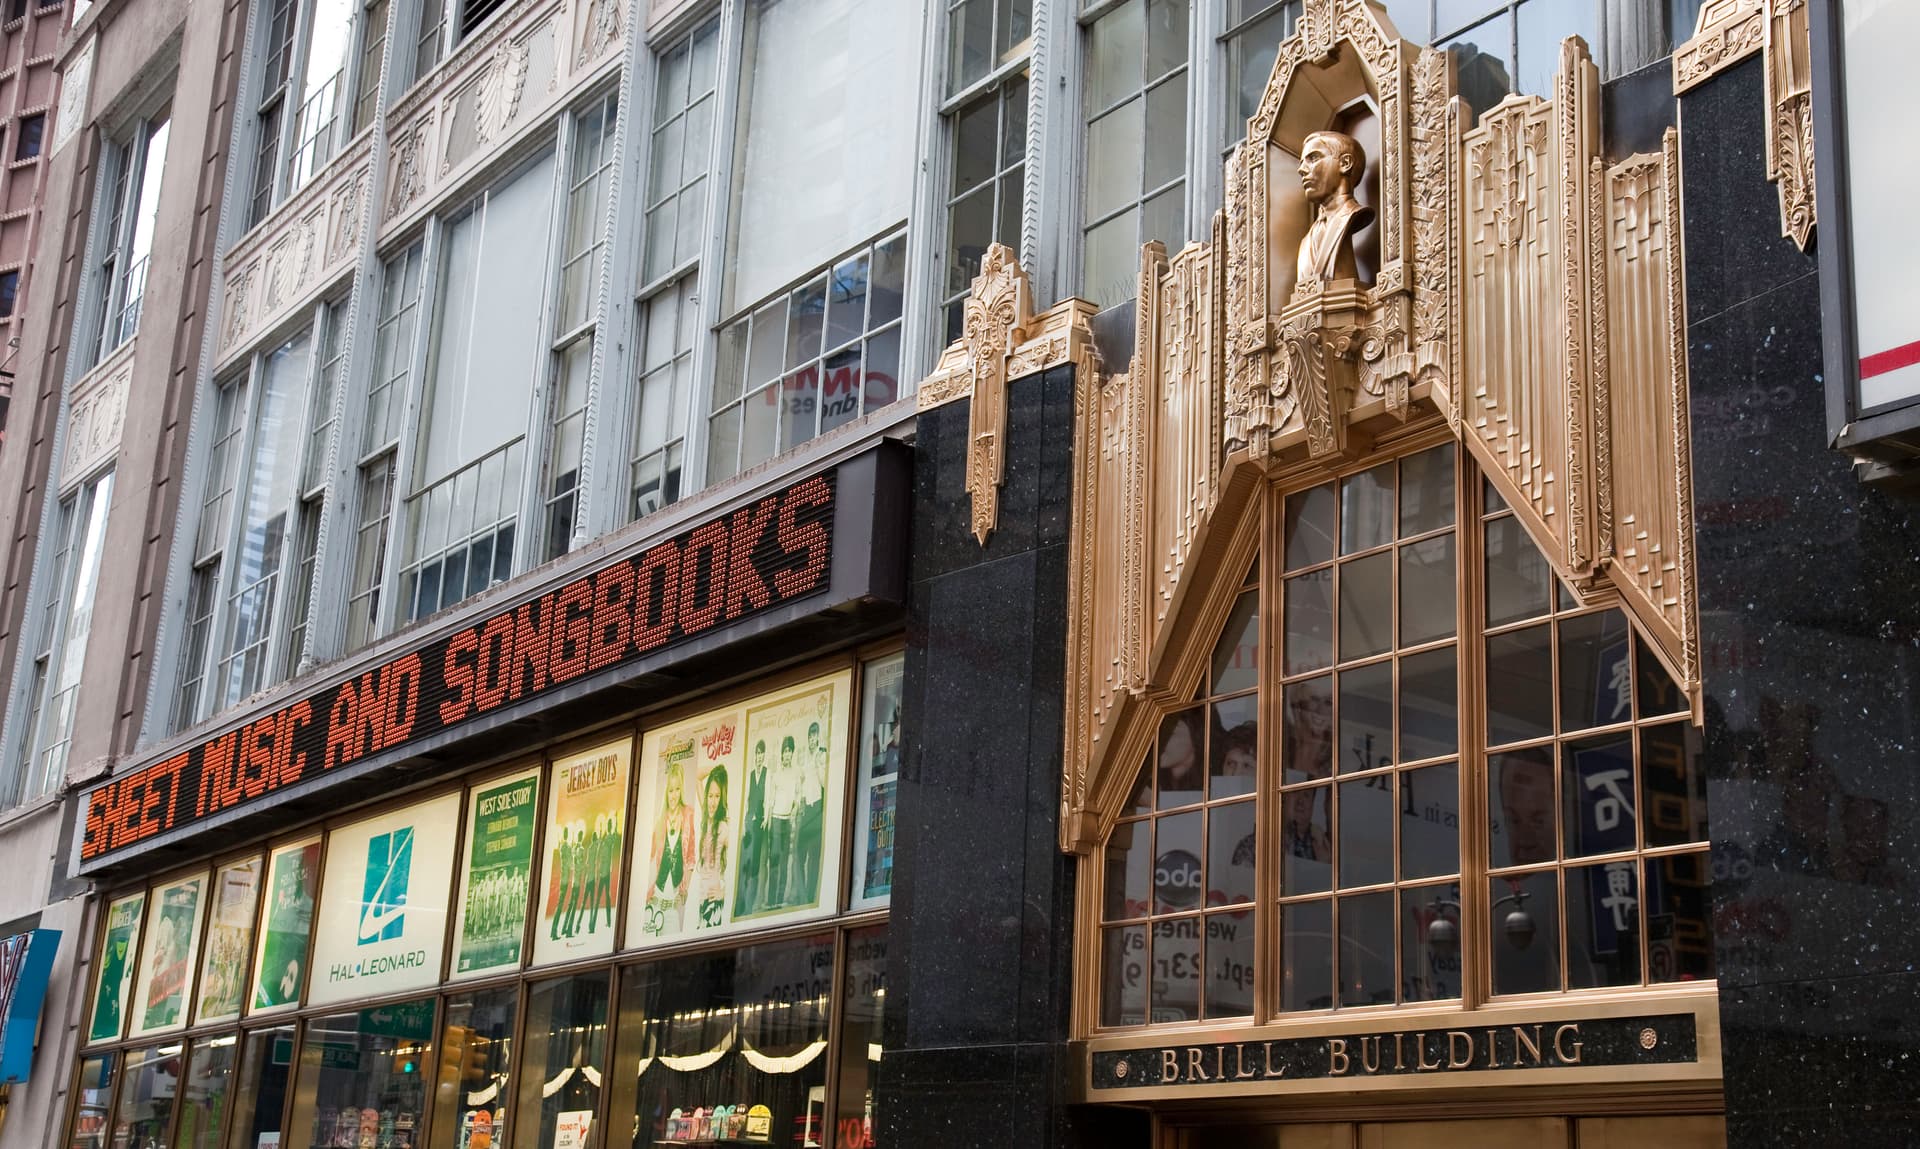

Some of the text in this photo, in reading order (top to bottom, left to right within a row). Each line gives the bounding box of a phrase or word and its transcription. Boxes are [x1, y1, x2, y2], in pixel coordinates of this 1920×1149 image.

[82, 477, 831, 860] SHEET MUSIC AND SONGBOOKS
[567, 760, 598, 793] JERSEY
[597, 753, 618, 784] BOYS
[480, 785, 532, 817] WEST SIDE STORY
[329, 950, 425, 983] HAL LEONARD
[1160, 1023, 1585, 1083] BRILL BUILDING
